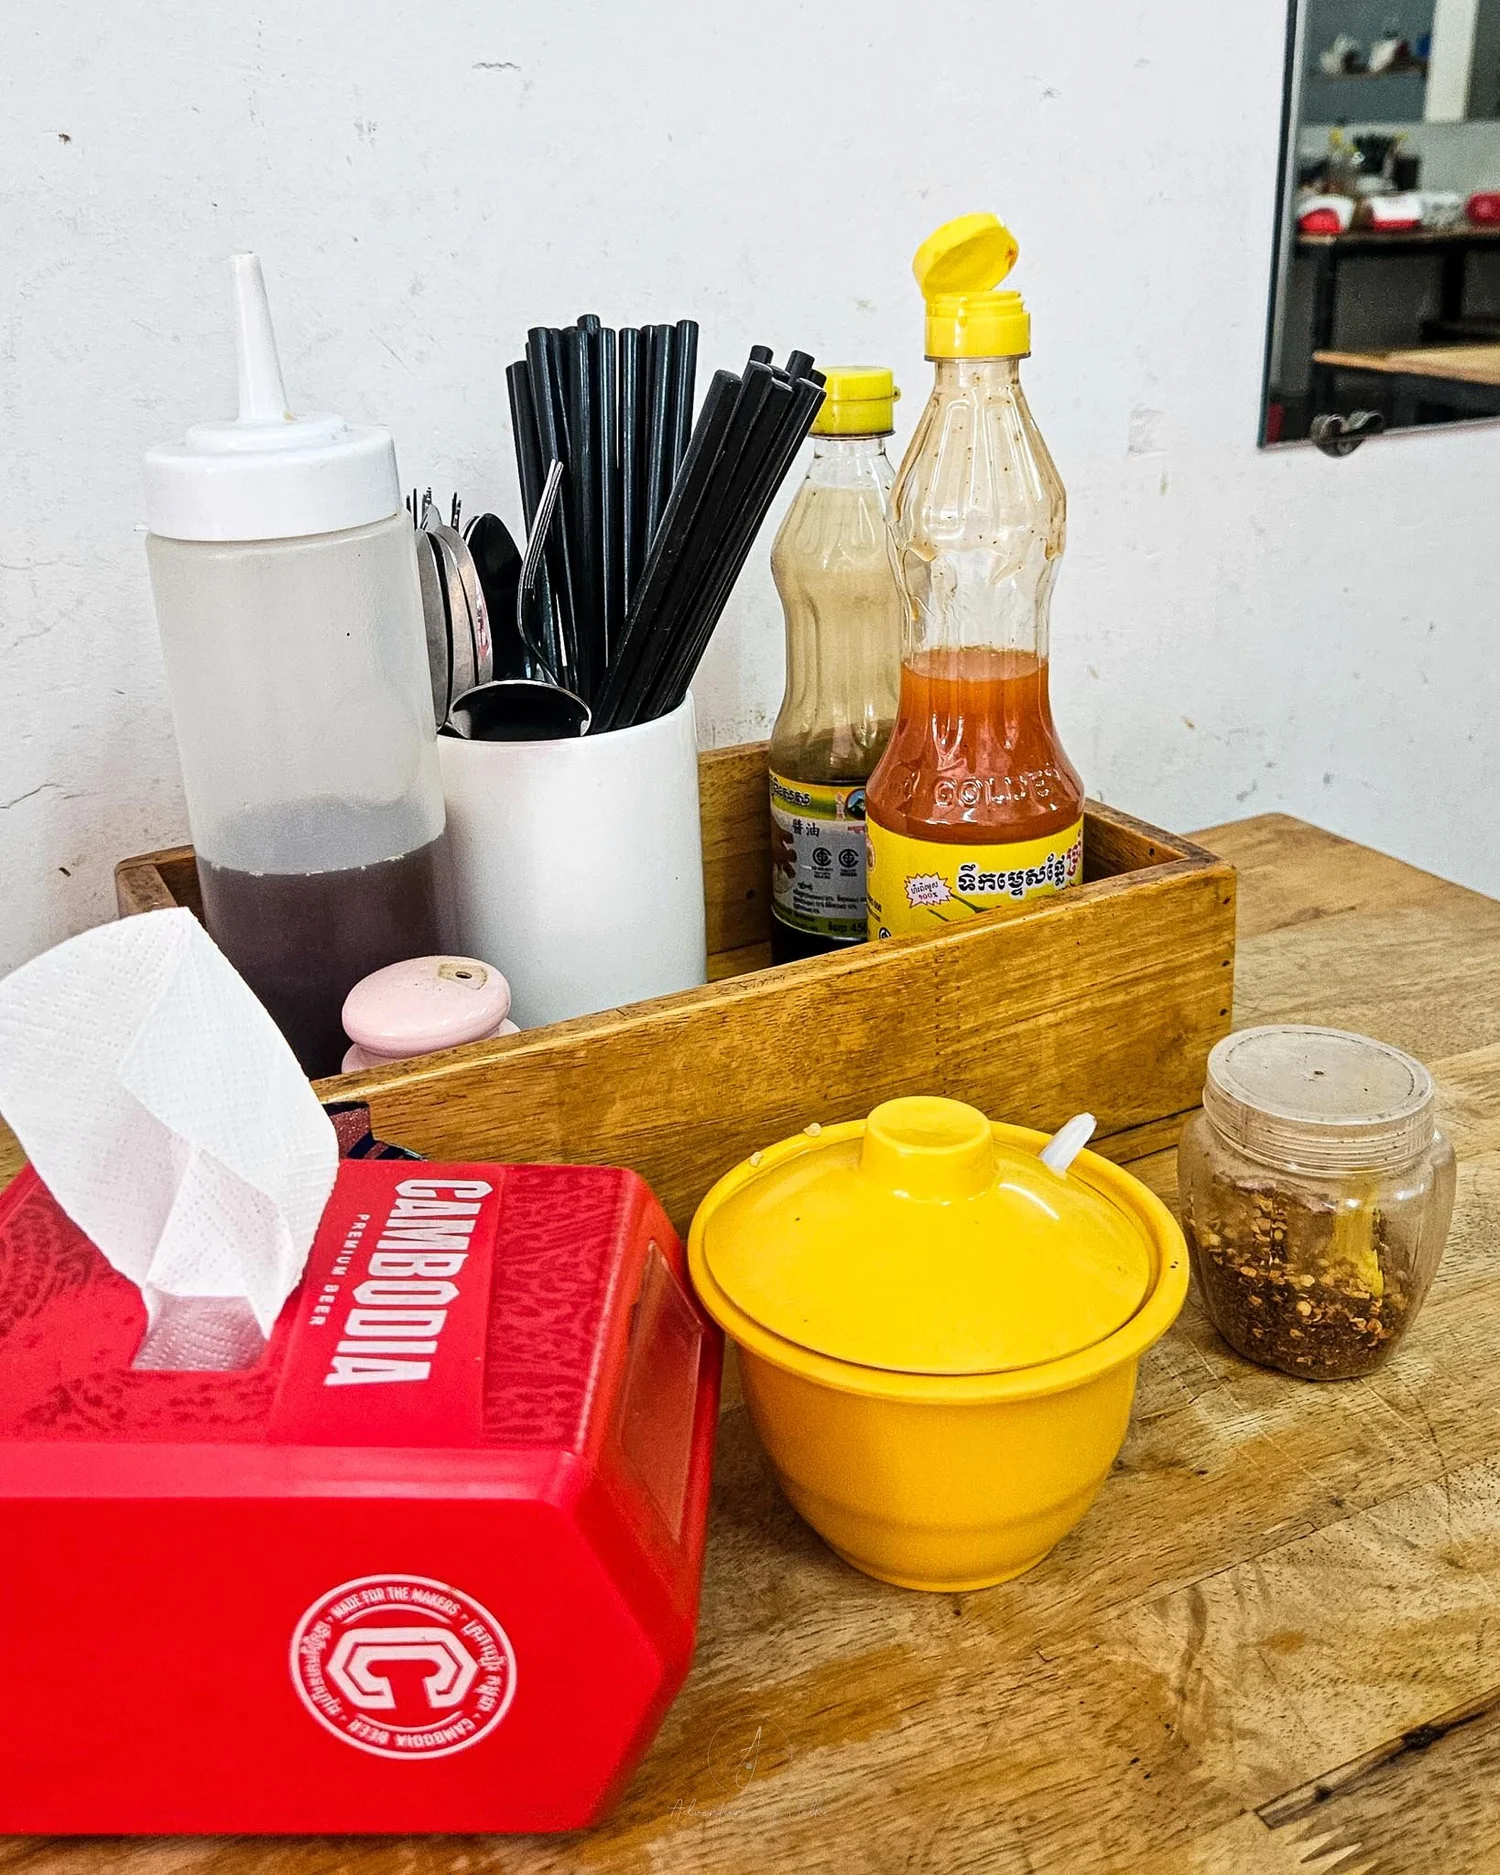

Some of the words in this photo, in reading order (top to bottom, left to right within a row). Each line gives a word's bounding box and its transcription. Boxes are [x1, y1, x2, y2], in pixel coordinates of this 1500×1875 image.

[331, 1214, 371, 1276] PREMIUM
[323, 1179, 494, 1387] CAMBODIA
[308, 1284, 340, 1326] BEER
[331, 1593, 363, 1620] MADE
[362, 1587, 385, 1604] FOR
[387, 1586, 410, 1601] THE
[412, 1587, 461, 1616] MAKERS
[346, 1718, 391, 1746] BEER
[393, 1717, 476, 1749] CAMBODIA
